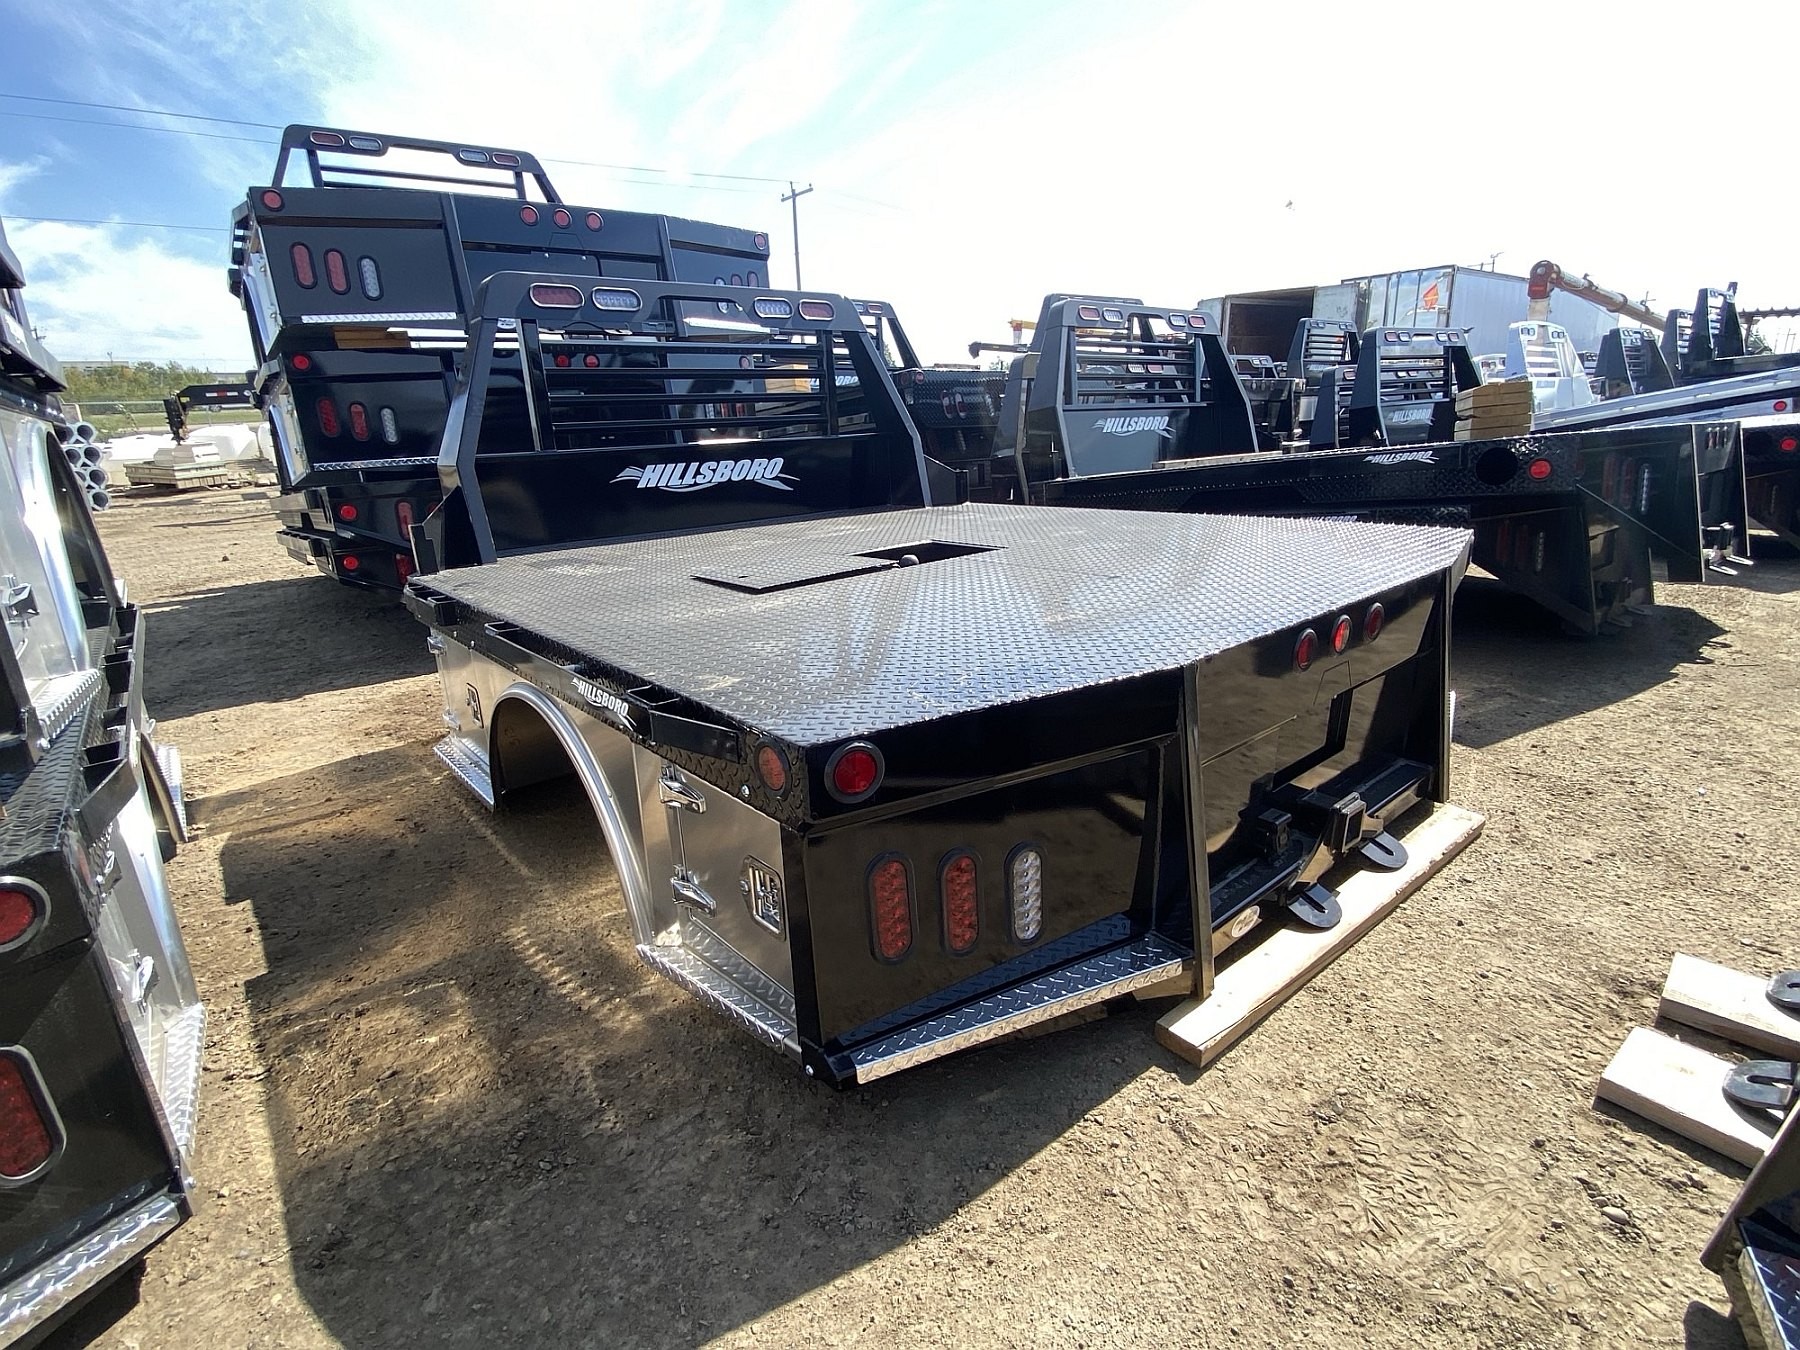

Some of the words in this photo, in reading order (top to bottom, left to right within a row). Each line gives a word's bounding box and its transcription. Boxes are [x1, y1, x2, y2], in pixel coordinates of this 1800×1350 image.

[1102, 416, 1169, 433] HILLSBORO
[1370, 450, 1433, 464] HILLSBORO
[636, 457, 784, 489] HILLSBORO
[578, 680, 629, 717] HILLSBORO
